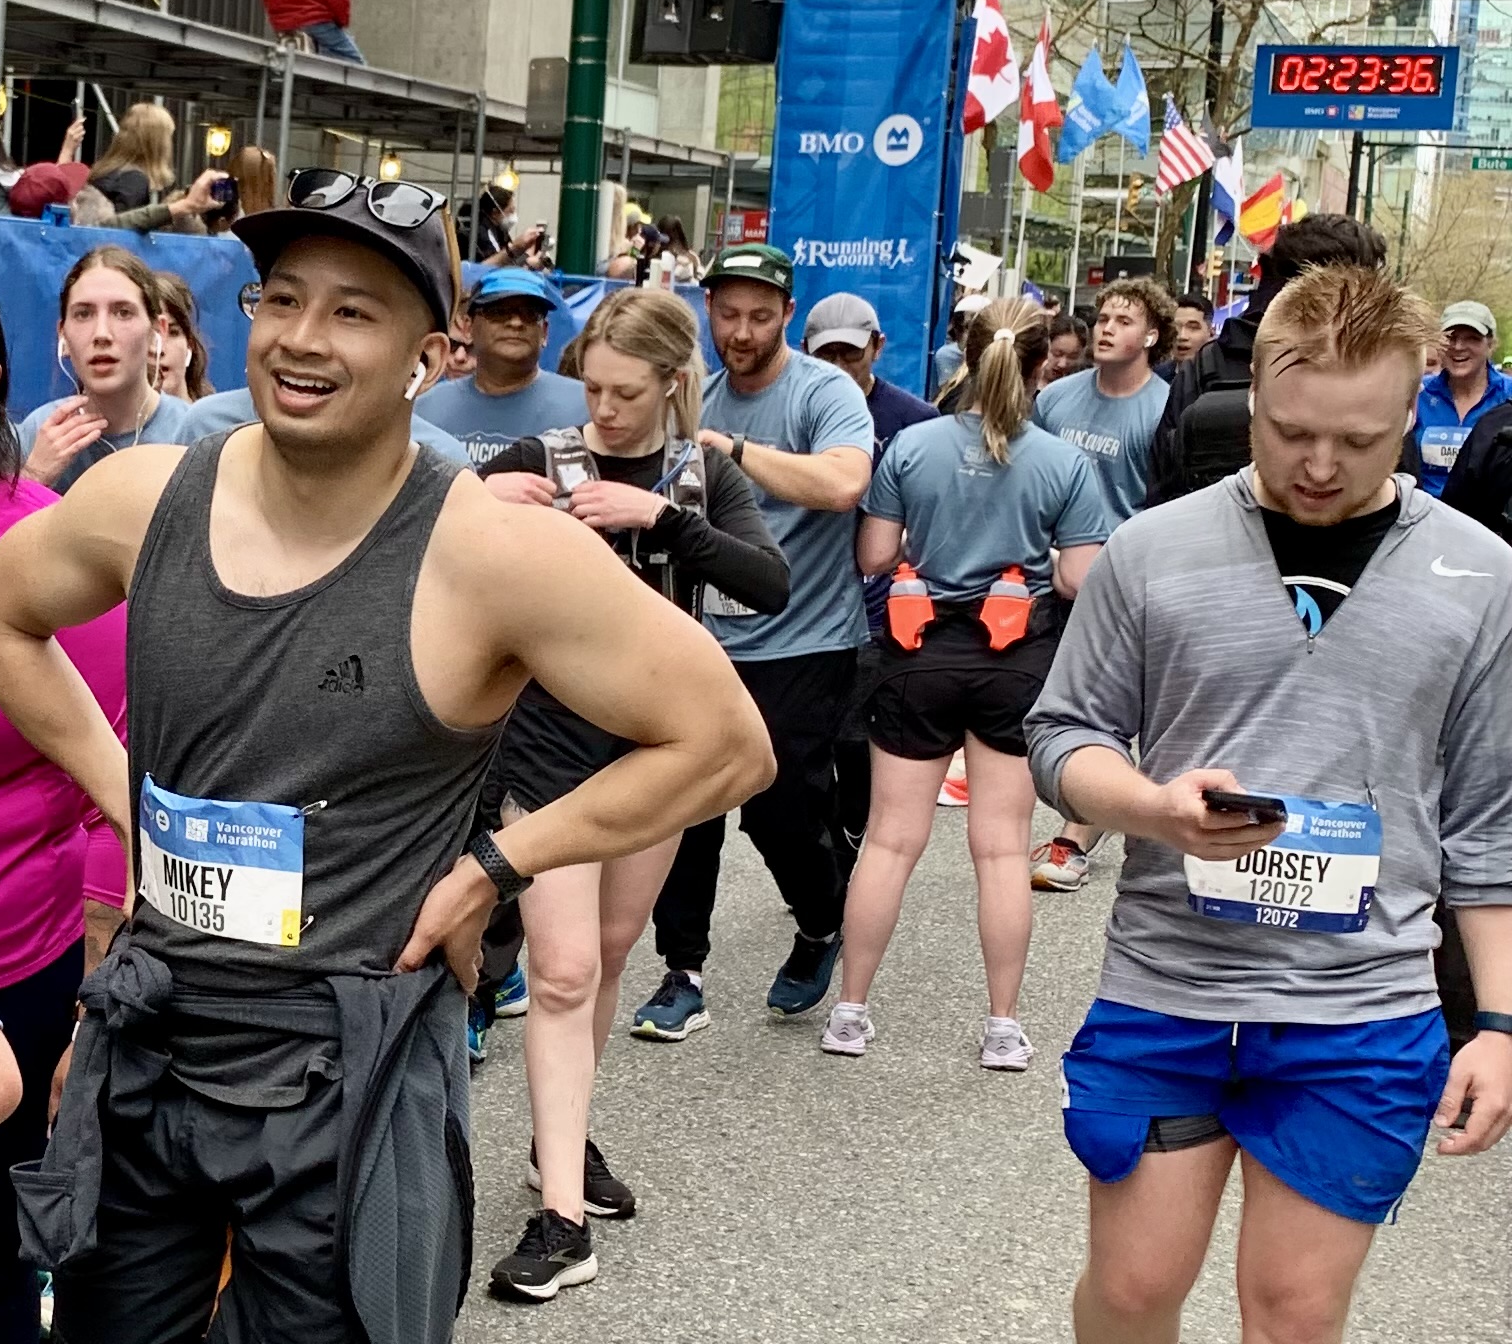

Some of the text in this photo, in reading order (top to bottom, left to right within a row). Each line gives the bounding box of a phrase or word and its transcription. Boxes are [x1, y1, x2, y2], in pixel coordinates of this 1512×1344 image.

[798, 132, 865, 154] BMO
[1478, 158, 1508, 169] Bute
[807, 236, 895, 267] Running
[216, 821, 283, 839] Vancouver
[1309, 815, 1367, 831] Vancouver
[1309, 825, 1363, 839] Marathon
[216, 833, 278, 851] Marathon
[1235, 848, 1333, 884] DORSEY
[162, 853, 234, 902] MIKEY
[1249, 878, 1315, 908] 12072
[169, 891, 226, 933] 10135
[1255, 906, 1300, 929] 12072
